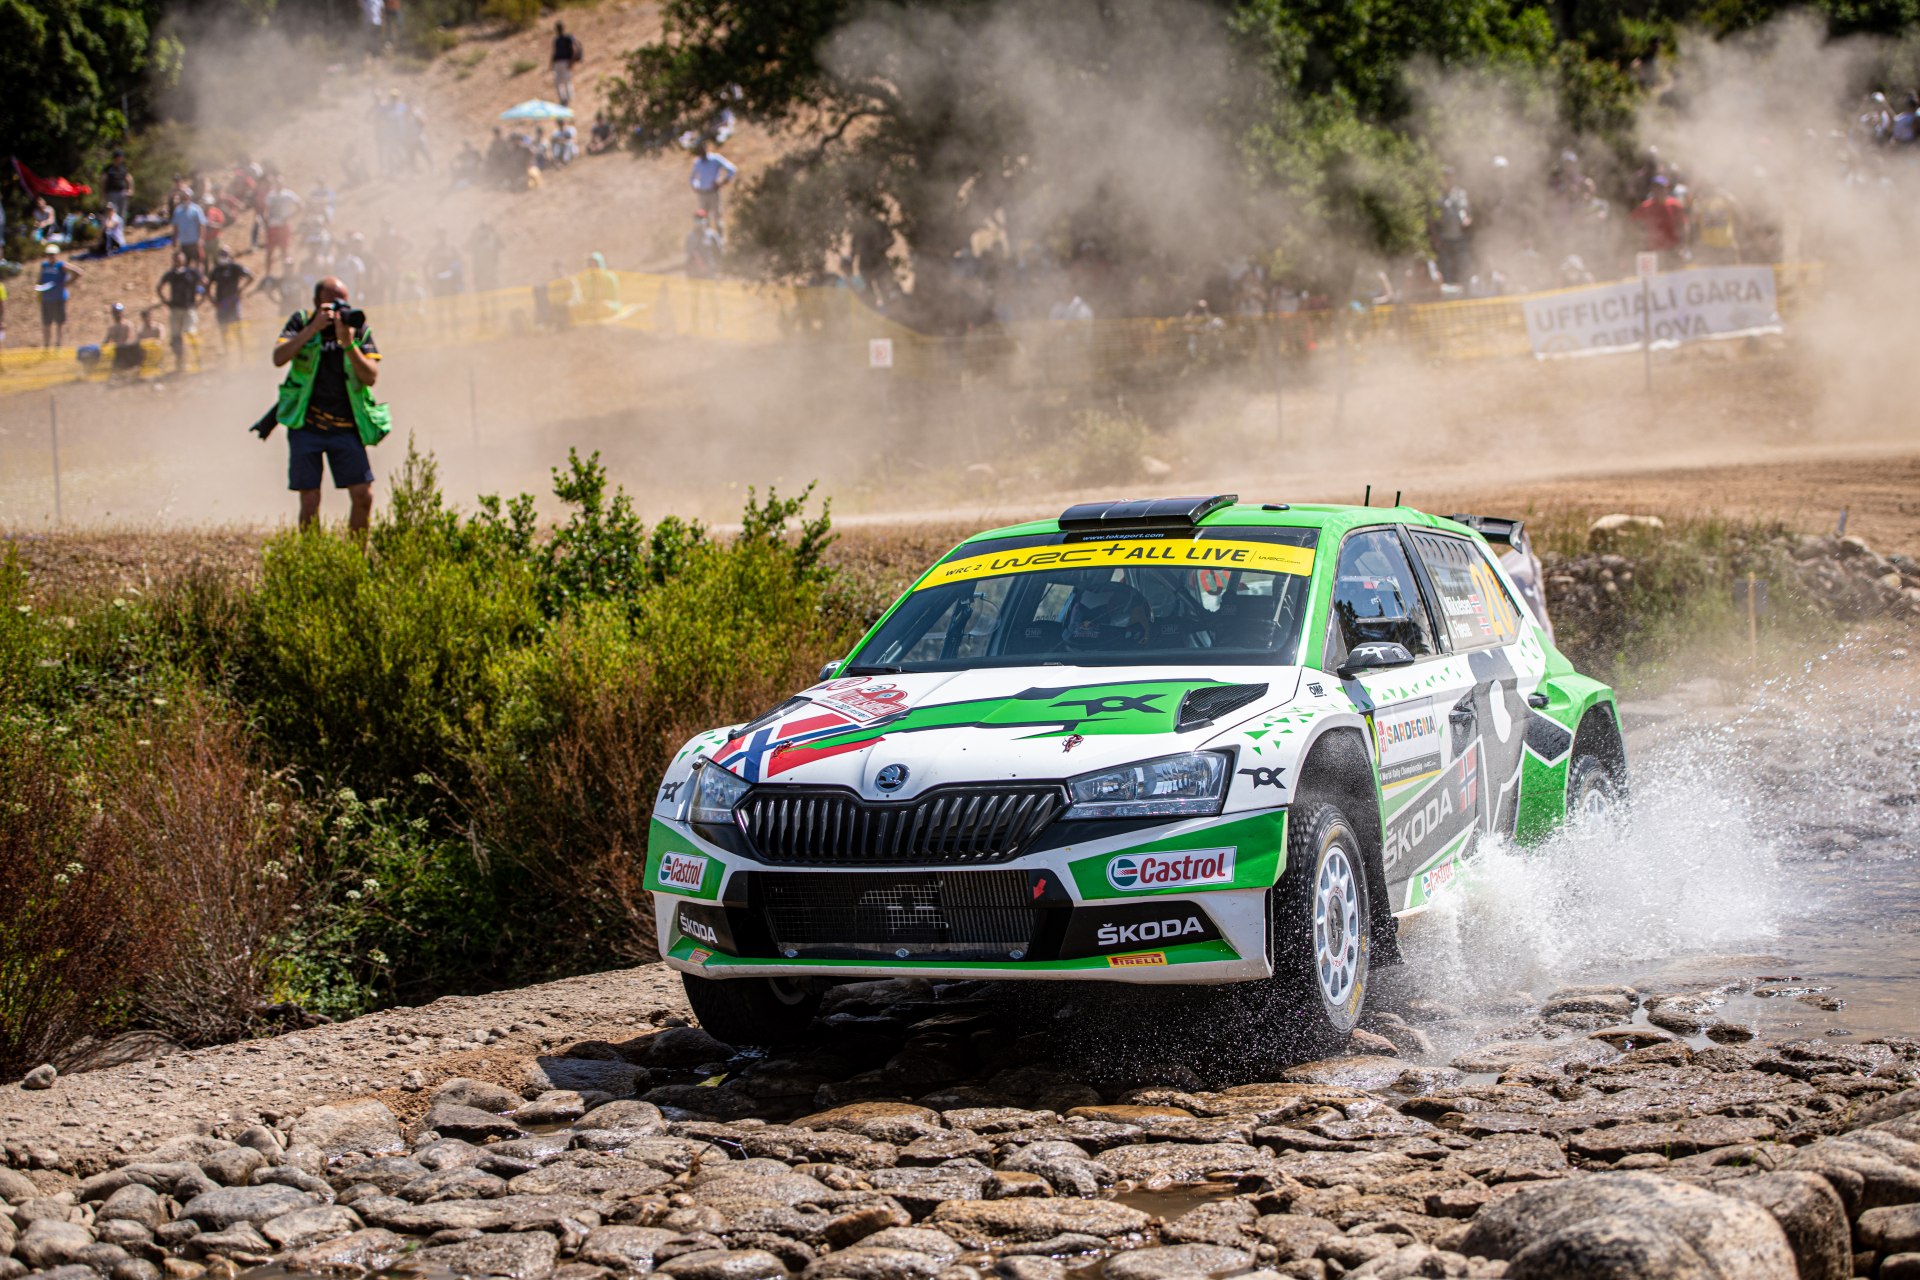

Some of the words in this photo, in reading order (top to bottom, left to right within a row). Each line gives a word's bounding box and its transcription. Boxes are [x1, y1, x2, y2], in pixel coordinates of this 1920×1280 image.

[1536, 287, 1677, 332] UFFICIALI
[1685, 278, 1762, 306] GARA
[1124, 546, 1176, 560] ALL
[1185, 547, 1250, 562] LIVE
[946, 565, 970, 576] WRC
[1469, 561, 1514, 636] 20
[1386, 715, 1437, 745] SARDEGNA
[1383, 787, 1453, 873] ŠKODA
[670, 858, 702, 886] Castrol
[1140, 852, 1226, 884] Castrol
[680, 911, 719, 944] ŠKODA
[1097, 916, 1205, 946] ŠKODA
[1110, 953, 1164, 966] PIRELLI
